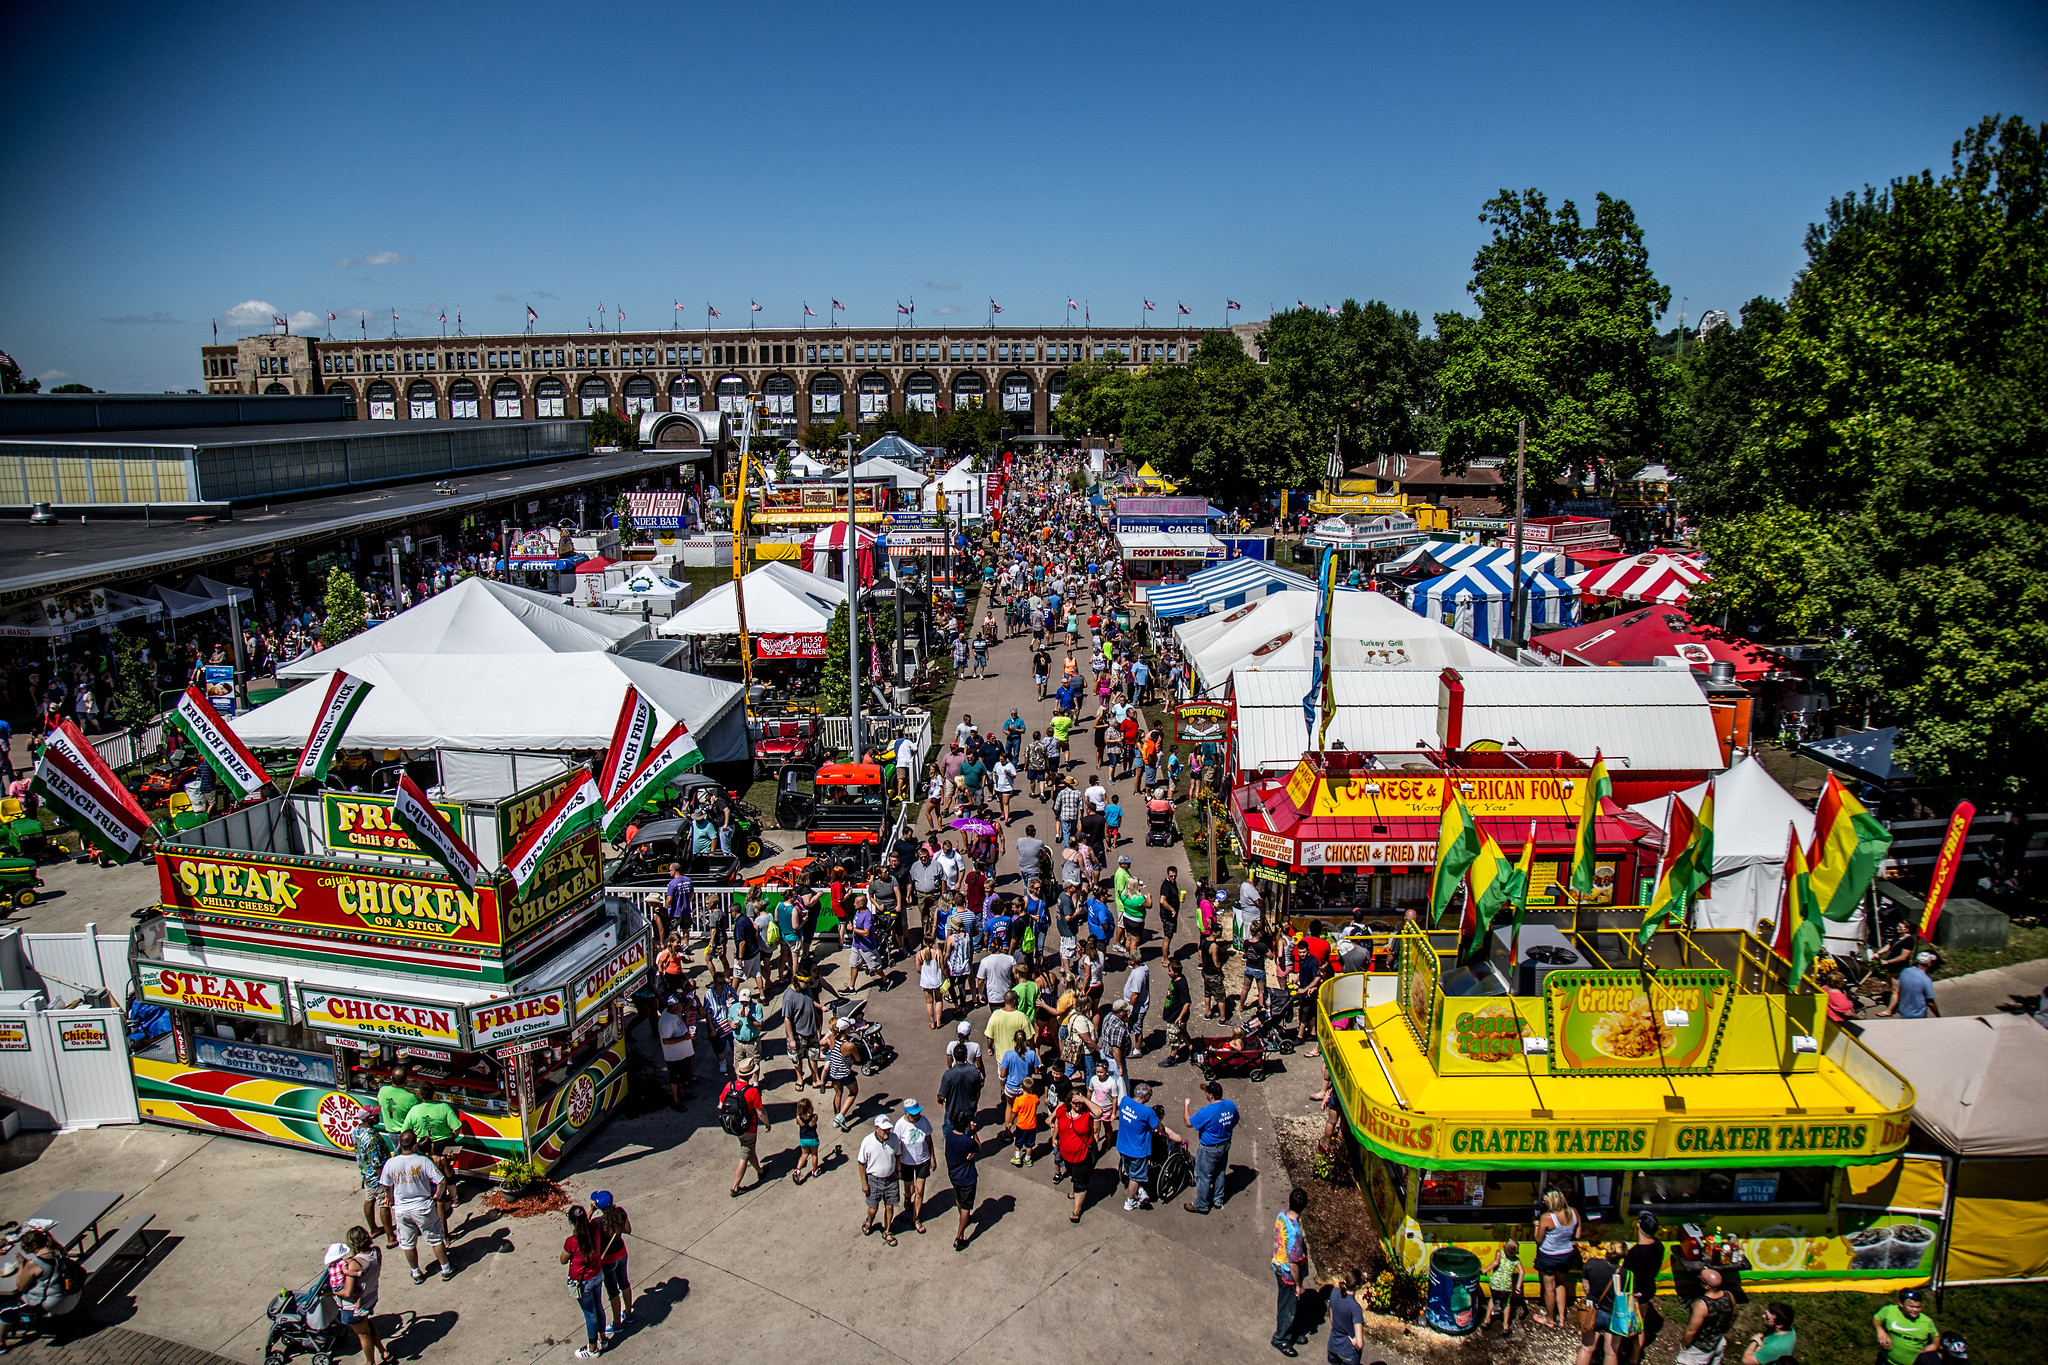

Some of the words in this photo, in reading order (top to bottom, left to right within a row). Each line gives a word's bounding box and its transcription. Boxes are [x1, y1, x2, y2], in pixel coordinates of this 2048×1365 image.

[1121, 502, 1175, 513] ELEPHANT
[1177, 502, 1205, 513] EARS
[660, 518, 679, 526] BAR
[1121, 525, 1162, 533] FUNNEL
[1168, 525, 1205, 533] CAKES
[1360, 525, 1384, 534] COTTON
[1392, 522, 1413, 531] CANDY
[1133, 549, 1156, 557] FOOT
[1157, 549, 1185, 557] LONGS
[63, 623, 80, 633] STONE
[81, 619, 97, 630] HANDS
[814, 635, 823, 643] SO
[1359, 639, 1384, 648] Turkey
[1388, 639, 1404, 648] Grill
[1180, 707, 1206, 719] TURKEY
[1206, 706, 1225, 718] GRILL
[305, 720, 334, 767] CHICKEN
[332, 683, 355, 712] STICK
[630, 702, 647, 743] FRIES
[183, 702, 225, 755] FRENCH
[219, 749, 252, 783] FRIES
[613, 750, 673, 814] CHICKEN
[1427, 784, 1437, 797] &
[95, 812, 128, 844] FRIES
[349, 833, 380, 846] Chili
[383, 835, 395, 848] &
[1252, 839, 1293, 855] DRUMMETTES
[1259, 833, 1286, 846] CHICKEN
[1303, 843, 1321, 854] SWEET
[1258, 847, 1276, 858] FRIED
[1277, 851, 1292, 862] RICE
[1307, 855, 1322, 863] SOUR
[1325, 844, 1370, 863] CHICKEN
[1372, 848, 1382, 859] &
[1384, 844, 1415, 863] FRIED
[179, 860, 297, 910] STEAK
[317, 875, 351, 888] Cajun
[1256, 872, 1287, 885] LEMONADE
[202, 896, 236, 908] PHILLY
[238, 900, 276, 913] CHEESE
[337, 880, 481, 931] CHICKEN
[508, 860, 598, 932] CHICKEN
[374, 916, 393, 928] ON
[395, 919, 405, 929] A
[407, 920, 445, 934] STICK
[586, 938, 645, 998] CHICKEN
[143, 979, 161, 987] CHEESE
[160, 969, 273, 1010] STEAK
[600, 987, 608, 998] on
[615, 968, 633, 986] Stick
[182, 994, 245, 1013] SANDWICH
[306, 995, 326, 1010] Cajun
[1577, 981, 1635, 1013] Grater
[1650, 985, 1701, 1012] Taters
[327, 997, 450, 1034] CHICKEN
[476, 994, 561, 1033] FRIES
[1456, 1012, 1529, 1034] Grater
[62, 1028, 107, 1042] Chicken
[358, 1022, 374, 1031] on
[388, 1024, 424, 1037] Stick
[492, 1026, 511, 1039] Chili
[513, 1025, 521, 1035] &
[523, 1019, 550, 1032] Cheese
[577, 1018, 594, 1035] NACHOS
[335, 1037, 359, 1048] NACHOS
[498, 1044, 524, 1058] CHICKEN
[530, 1038, 548, 1050] STICK
[1457, 1033, 1522, 1054] Taters
[227, 1045, 256, 1062] ICE
[257, 1050, 301, 1068] COLD
[408, 1046, 429, 1056] CHICKEN
[435, 1051, 450, 1060] STICK
[227, 1058, 269, 1072] BOTTLED
[270, 1065, 304, 1078] WATER
[320, 1095, 338, 1117] THE
[339, 1095, 361, 1117] BES
[1359, 1099, 1434, 1151] DRINKS
[1372, 1107, 1411, 1128] COLD
[323, 1122, 357, 1148] AROU
[1452, 1128, 1550, 1153] GRATER
[1555, 1128, 1647, 1153] TATERS
[1676, 1125, 1772, 1152] GRATER
[1777, 1124, 1867, 1151] TATERS
